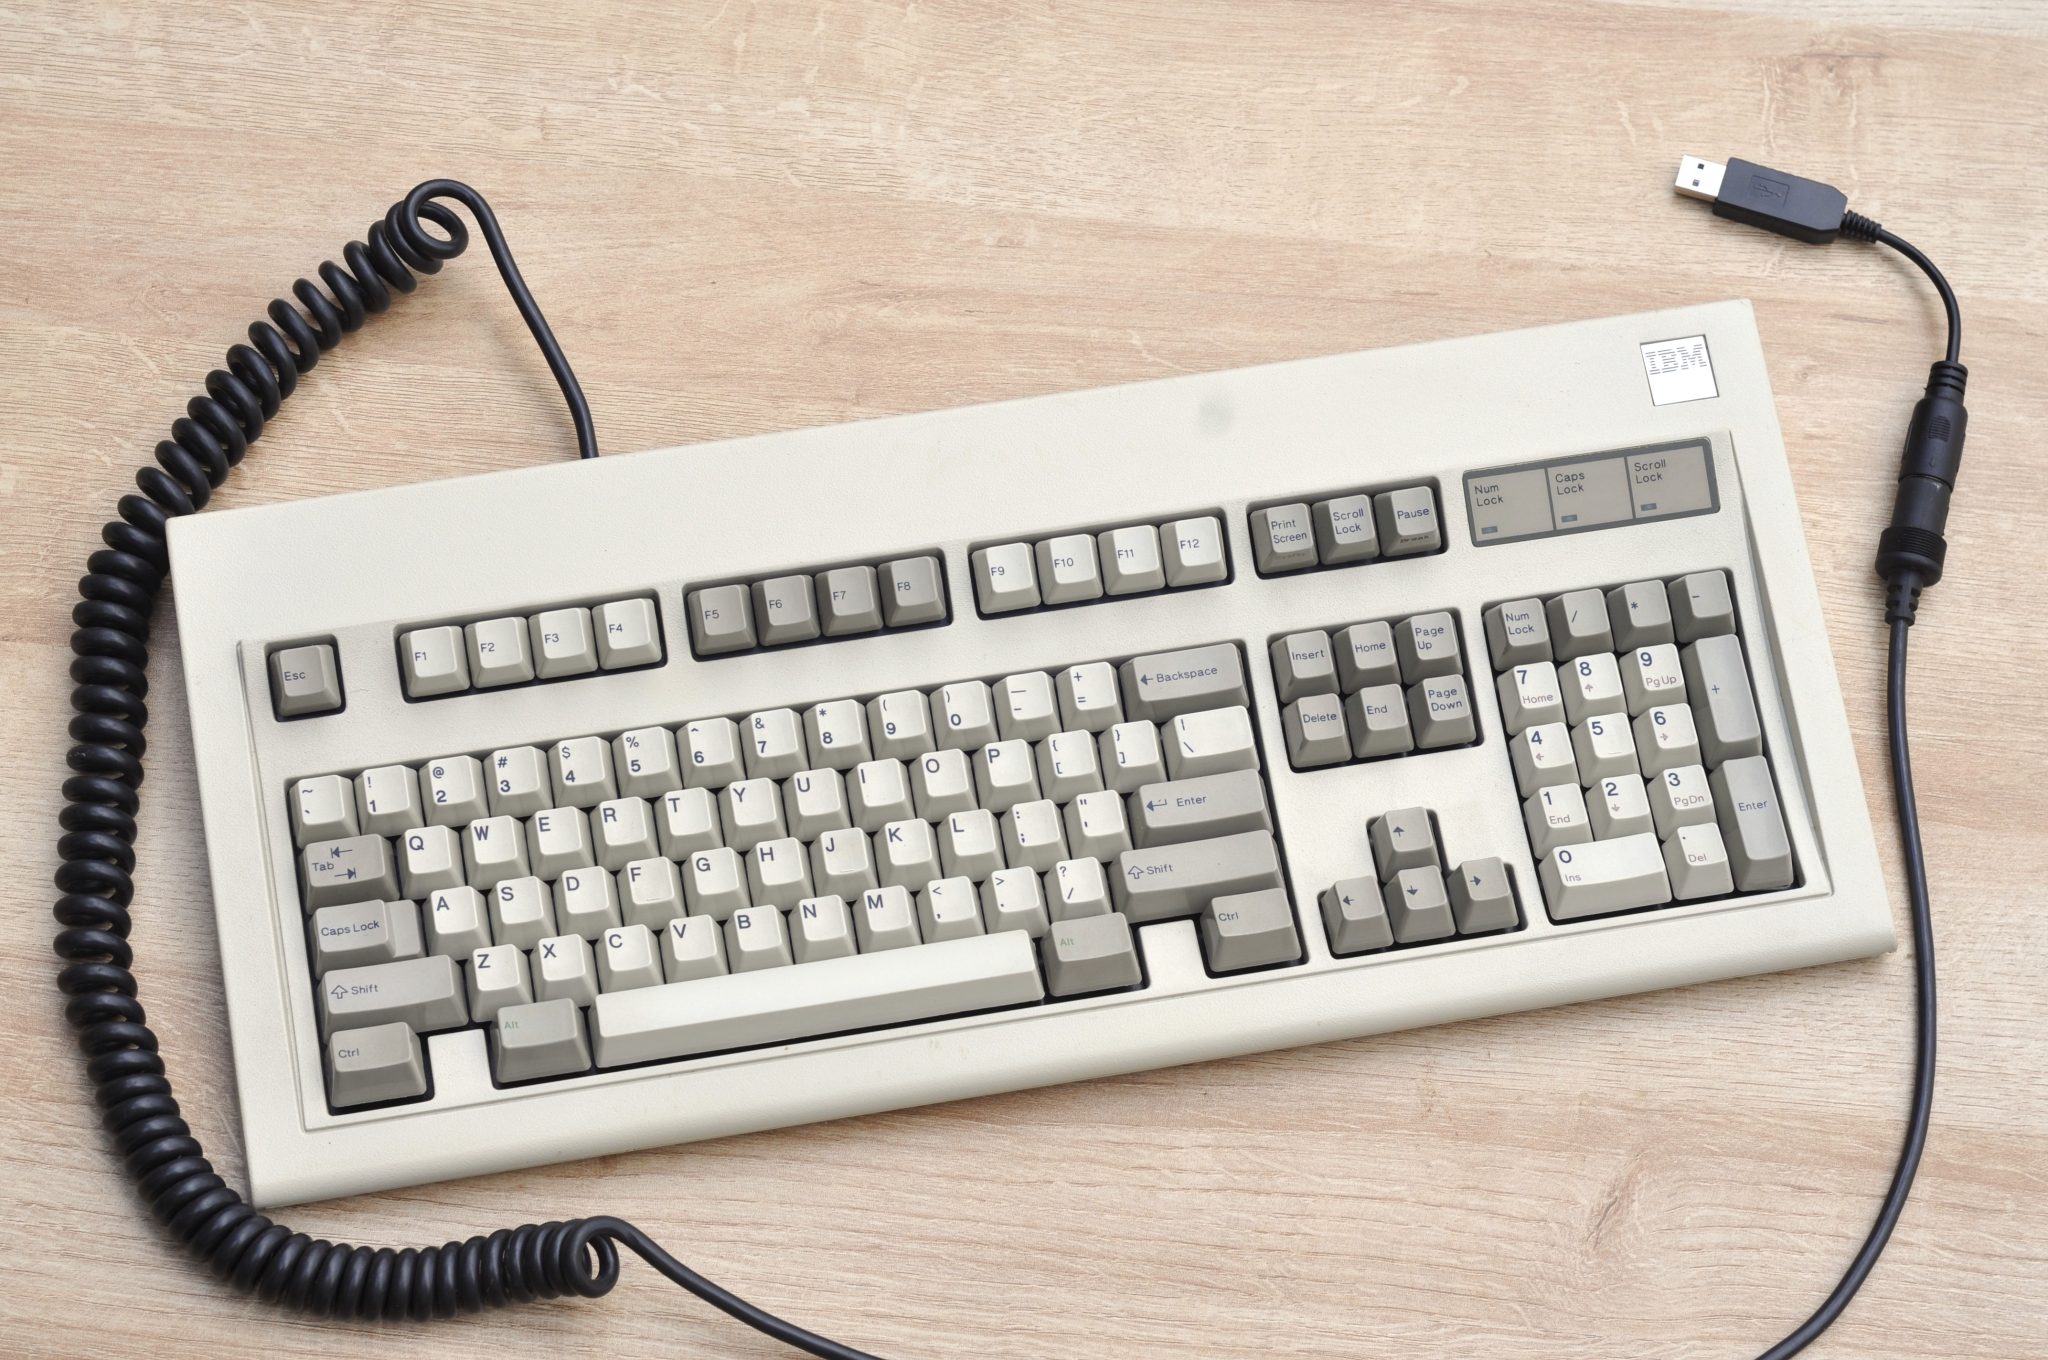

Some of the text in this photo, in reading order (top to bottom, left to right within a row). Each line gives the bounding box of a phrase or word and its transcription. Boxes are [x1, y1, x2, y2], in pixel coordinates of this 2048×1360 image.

[1645, 344, 1708, 375] IBM
[1634, 459, 1666, 472] Scroll
[1556, 473, 1585, 483] Caps
[1636, 472, 1662, 484] Lock
[1475, 485, 1499, 494] Num
[1557, 483, 1584, 495] Lock
[1477, 495, 1503, 507] Lock
[1333, 508, 1364, 521] Scroll
[1397, 508, 1429, 519] Pause
[1271, 520, 1296, 530] Print
[1335, 523, 1361, 535] Lock
[1180, 539, 1199, 549] F12
[1273, 532, 1307, 544] Screen
[1118, 549, 1134, 559] F11
[1054, 558, 1073, 568] F10
[991, 566, 1005, 576] F9
[897, 582, 911, 591] F8
[833, 591, 846, 600] F7
[769, 599, 782, 609] F6
[705, 610, 719, 620] F5
[1505, 613, 1529, 622] Num
[1571, 610, 1578, 623] /
[609, 624, 622, 633] F4
[1415, 627, 1444, 637] Page
[1508, 624, 1534, 635] Lock
[544, 633, 559, 644] F3
[481, 643, 495, 652] F2
[1355, 643, 1386, 653] Home
[1418, 641, 1432, 650] Up
[415, 652, 426, 661] F1
[1292, 650, 1324, 660] Insert
[1640, 652, 1652, 667] 9
[1156, 668, 1217, 682] Backspace
[1580, 662, 1592, 676] 8
[284, 671, 305, 681] Esc
[1074, 672, 1082, 682] +
[1517, 670, 1527, 684] 7
[1428, 689, 1457, 699] Page
[1711, 685, 1720, 694] +
[945, 691, 951, 703] )
[1078, 696, 1086, 704] =
[1522, 695, 1553, 704] Home
[882, 700, 888, 711] (
[1367, 705, 1387, 715] End
[1431, 701, 1462, 711] Down
[755, 718, 765, 729] &
[1303, 713, 1337, 723] Delete
[1654, 711, 1666, 725] 6
[886, 722, 896, 735] 9
[1592, 721, 1603, 735] 5
[823, 732, 833, 744] 8
[1114, 729, 1121, 741] }
[1531, 731, 1542, 744] 4
[626, 736, 639, 748] %
[757, 741, 766, 753] 7
[1052, 740, 1059, 751] {
[1184, 742, 1194, 753] \
[562, 746, 571, 759] $
[694, 751, 704, 763] 6
[988, 749, 1000, 763] P
[1118, 752, 1127, 764] ]
[498, 756, 507, 768] #
[631, 760, 641, 772] 5
[926, 759, 940, 773] O
[1055, 762, 1063, 774] [
[433, 767, 444, 779] @
[565, 770, 575, 782] 4
[861, 769, 865, 783] I
[367, 776, 372, 788] !
[797, 777, 810, 792] U
[1668, 773, 1680, 786] 3
[500, 780, 510, 792] 3
[1606, 782, 1618, 796] 2
[436, 790, 447, 803] 2
[733, 787, 745, 802] Y
[1544, 792, 1552, 805] 1
[370, 800, 376, 812] 1
[668, 798, 680, 812] T
[1176, 796, 1206, 807] Enter
[1674, 795, 1704, 807] PgDn
[1738, 801, 1767, 811] Enter
[603, 808, 617, 823] R
[1549, 814, 1570, 824] End
[538, 817, 551, 832] E
[952, 818, 964, 832] L
[474, 825, 489, 841] W
[888, 828, 903, 842] K
[409, 836, 424, 851] Q
[826, 837, 834, 852] J
[760, 847, 774, 862] H
[1688, 854, 1707, 862] Del
[312, 861, 334, 871] Tab
[696, 857, 711, 872] G
[1146, 864, 1173, 875] Shift
[630, 867, 641, 882] F
[1059, 866, 1067, 877] ?
[566, 877, 579, 891] D
[995, 877, 1004, 885] >
[1565, 874, 1581, 882] Ins
[501, 887, 514, 901] S
[932, 887, 941, 895] <
[1066, 888, 1074, 899] /
[437, 896, 449, 911] A
[867, 894, 883, 909] M
[803, 904, 817, 918] N
[1218, 912, 1238, 921] Ctrl
[737, 915, 751, 929] B
[320, 920, 379, 939] Caps Lock
[673, 924, 686, 938] V
[609, 934, 622, 948] C
[1060, 938, 1074, 947] Alt
[543, 944, 556, 958] X
[477, 954, 491, 969] Z
[351, 984, 378, 995] Shift
[504, 1021, 519, 1029] Alt
[338, 1048, 359, 1058] Ctrl
